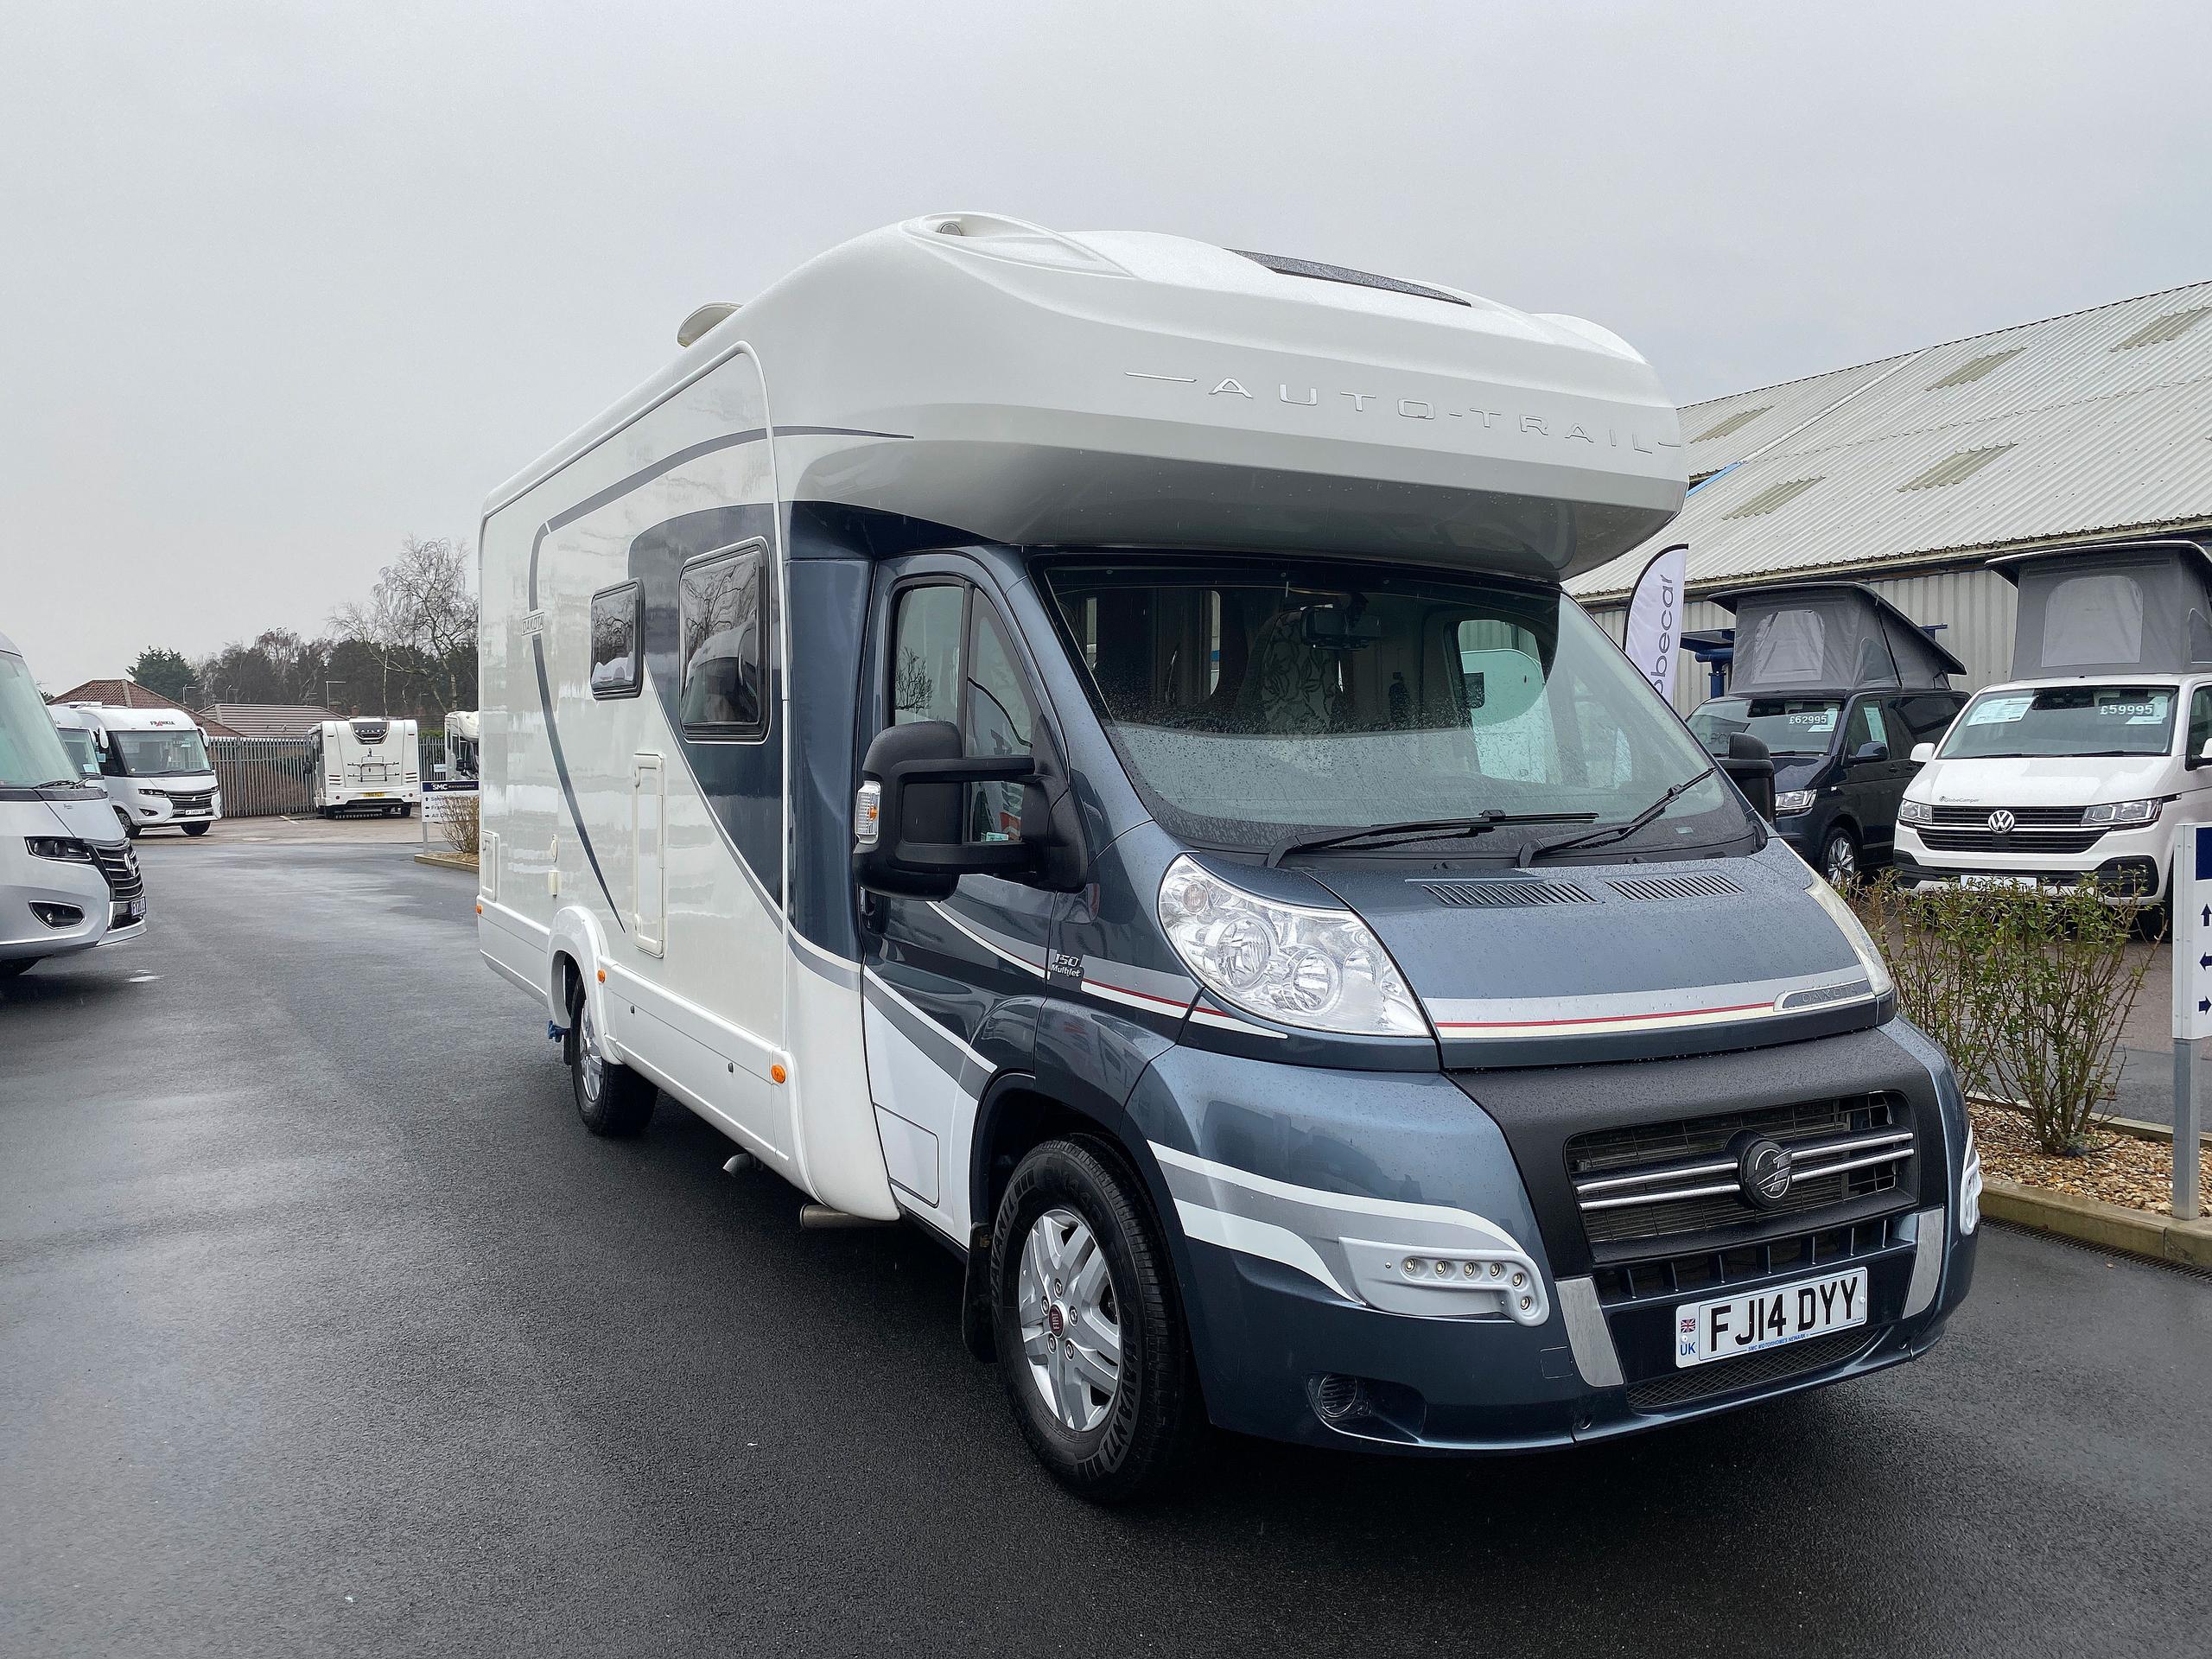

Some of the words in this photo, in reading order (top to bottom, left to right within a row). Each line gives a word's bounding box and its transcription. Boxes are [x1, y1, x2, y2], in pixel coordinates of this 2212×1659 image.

[1209, 377, 1652, 454] AUTO-TRAIL
[523, 614, 544, 633] DAKOTA
[2100, 704, 2153, 715] £59995
[1789, 715, 1827, 724] £62995
[1055, 953, 1079, 967] 150
[1052, 1312, 1060, 1330] FIAT
[1710, 1293, 1787, 1352] FJ14
[1797, 1276, 1858, 1332] DYY
[1680, 1341, 1696, 1356] UK
